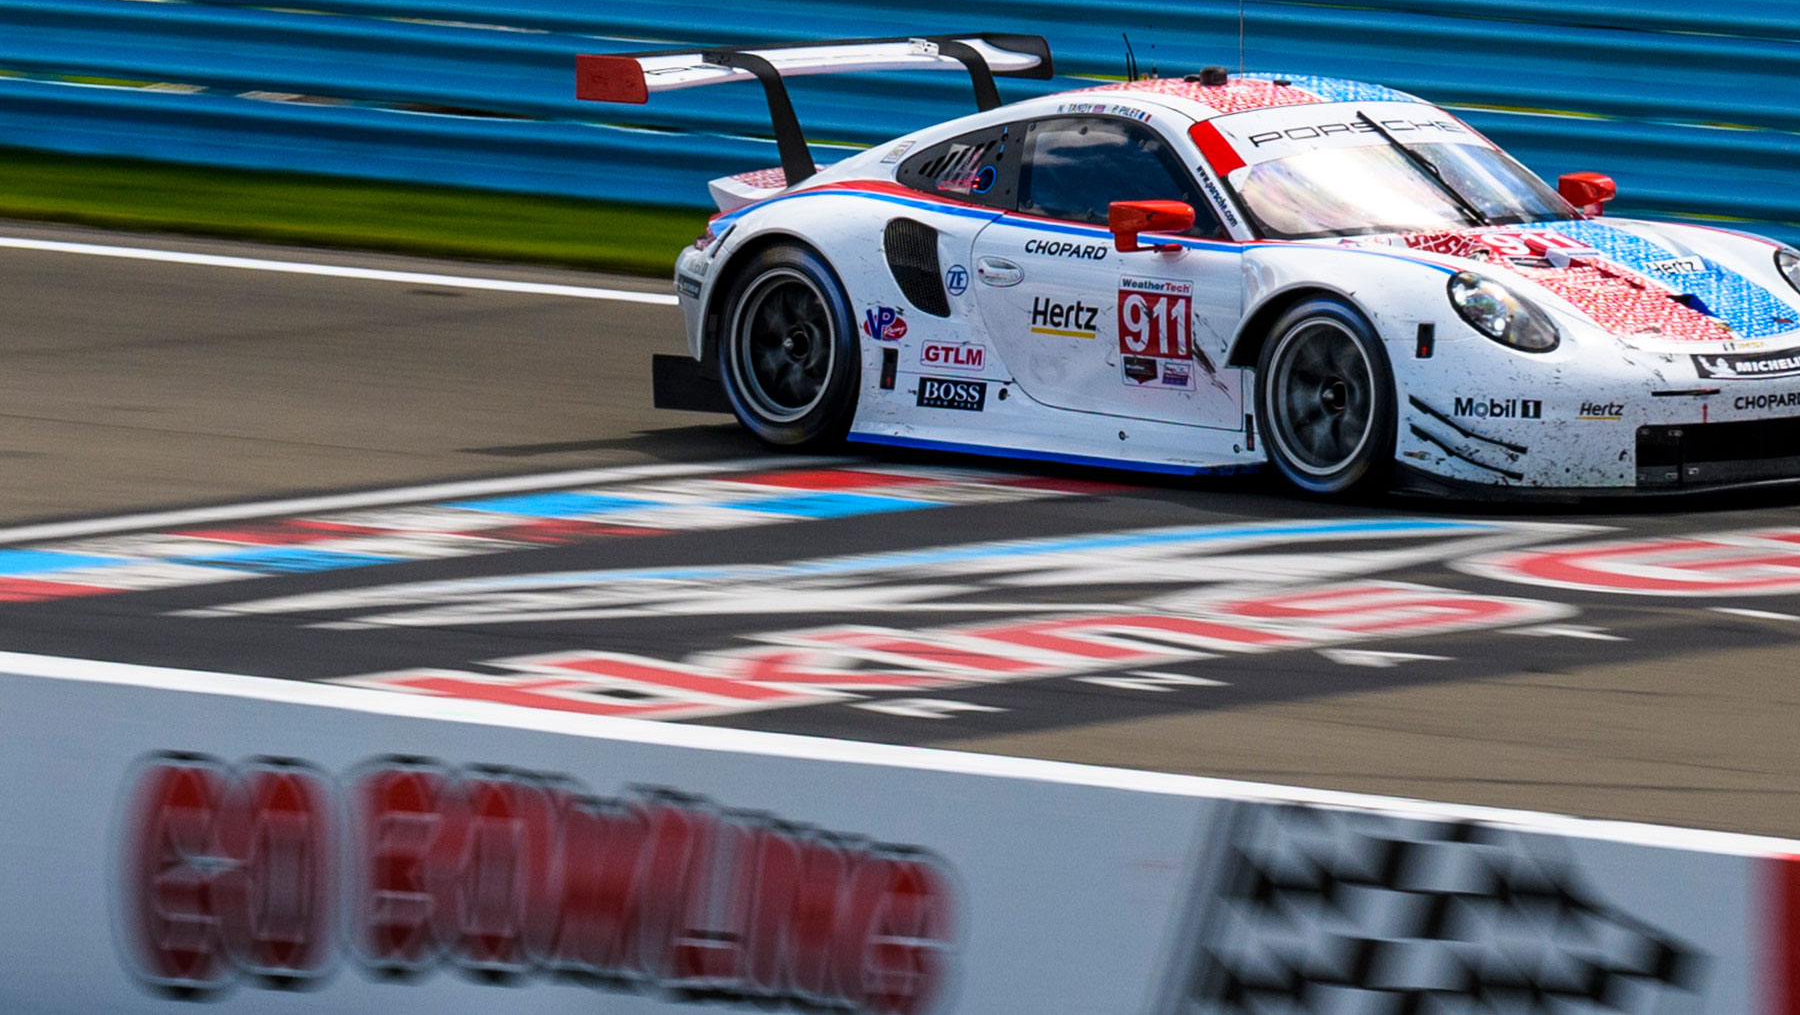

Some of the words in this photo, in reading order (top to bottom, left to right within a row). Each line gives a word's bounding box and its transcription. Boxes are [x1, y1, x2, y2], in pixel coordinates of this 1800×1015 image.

[1248, 118, 1467, 148] PORSCHE
[1196, 165, 1239, 227] www.porsche.com
[1024, 239, 1108, 261] CHOPARD
[1645, 259, 1698, 276] Hertz
[1122, 277, 1190, 294] WeatherTech
[865, 305, 895, 341] VP
[1031, 296, 1099, 331] Hertz
[1122, 293, 1188, 356] 911
[924, 344, 983, 367] GTLM
[924, 380, 980, 403] BOSS
[1454, 397, 1517, 419] Mobil
[1579, 401, 1625, 417] Hertz
